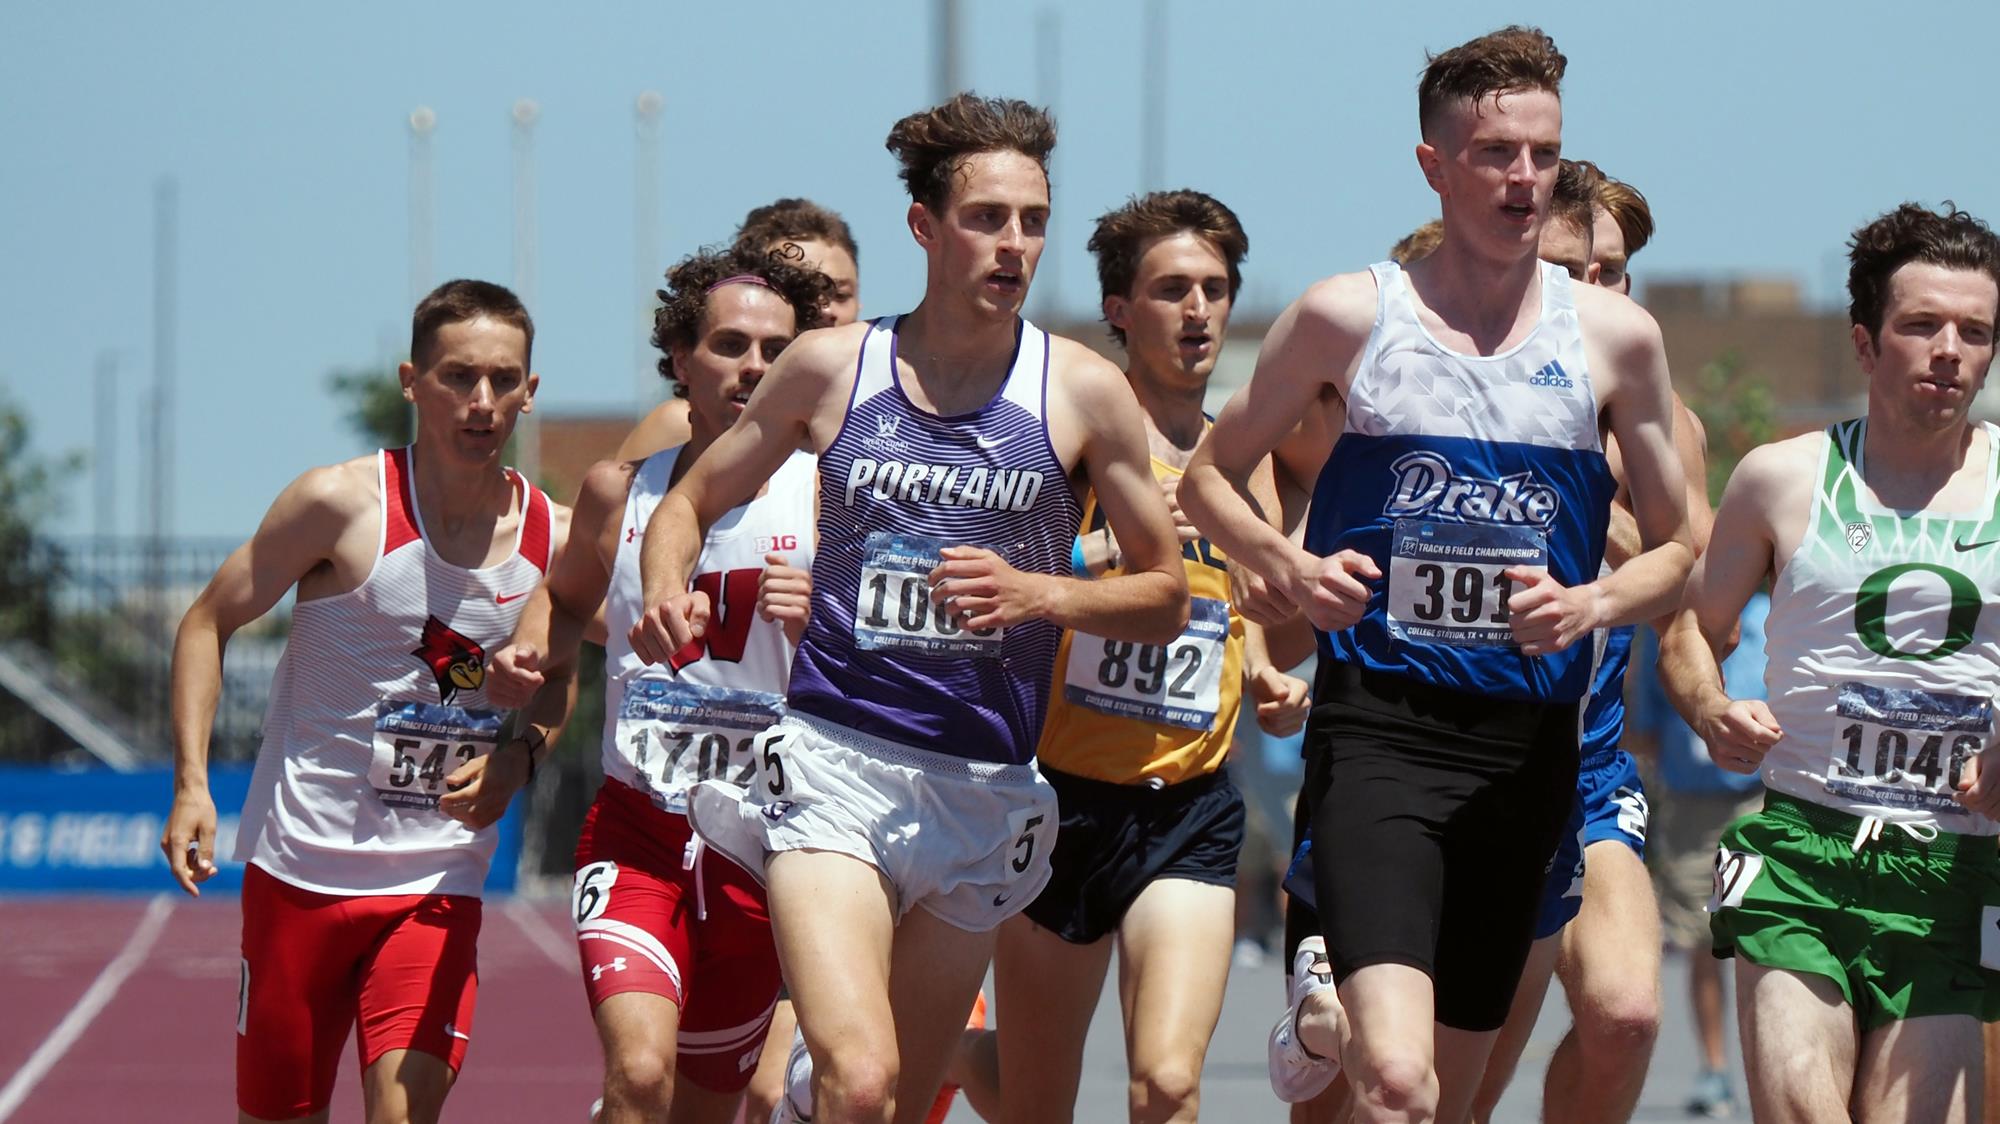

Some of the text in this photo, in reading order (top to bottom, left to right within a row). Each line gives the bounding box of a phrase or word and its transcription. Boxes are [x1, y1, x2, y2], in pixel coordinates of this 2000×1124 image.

[1529, 375, 1574, 389] adidas
[843, 457, 1045, 513] PORTLAND
[1383, 451, 1560, 528] Drake
[888, 554, 911, 565] TRACK
[917, 558, 939, 568] FIELD
[1418, 543, 1444, 555] TRACK
[1452, 546, 1474, 556] FIELD
[1475, 547, 1540, 558] CHAMPIONSHIPS
[1851, 535, 1865, 547] 12
[1413, 563, 1513, 624] 391
[1854, 562, 1983, 661] O
[873, 635, 900, 645] COLLEGE
[1407, 626, 1435, 638] COLLEGE
[1467, 631, 1476, 639] TX
[1487, 632, 1502, 640] MAY
[1097, 638, 1203, 701] 892
[1896, 711, 1919, 721] FIELD
[630, 728, 757, 789] 1702
[763, 734, 786, 796] 5
[1012, 814, 1045, 873] 5
[577, 866, 605, 924] 6
